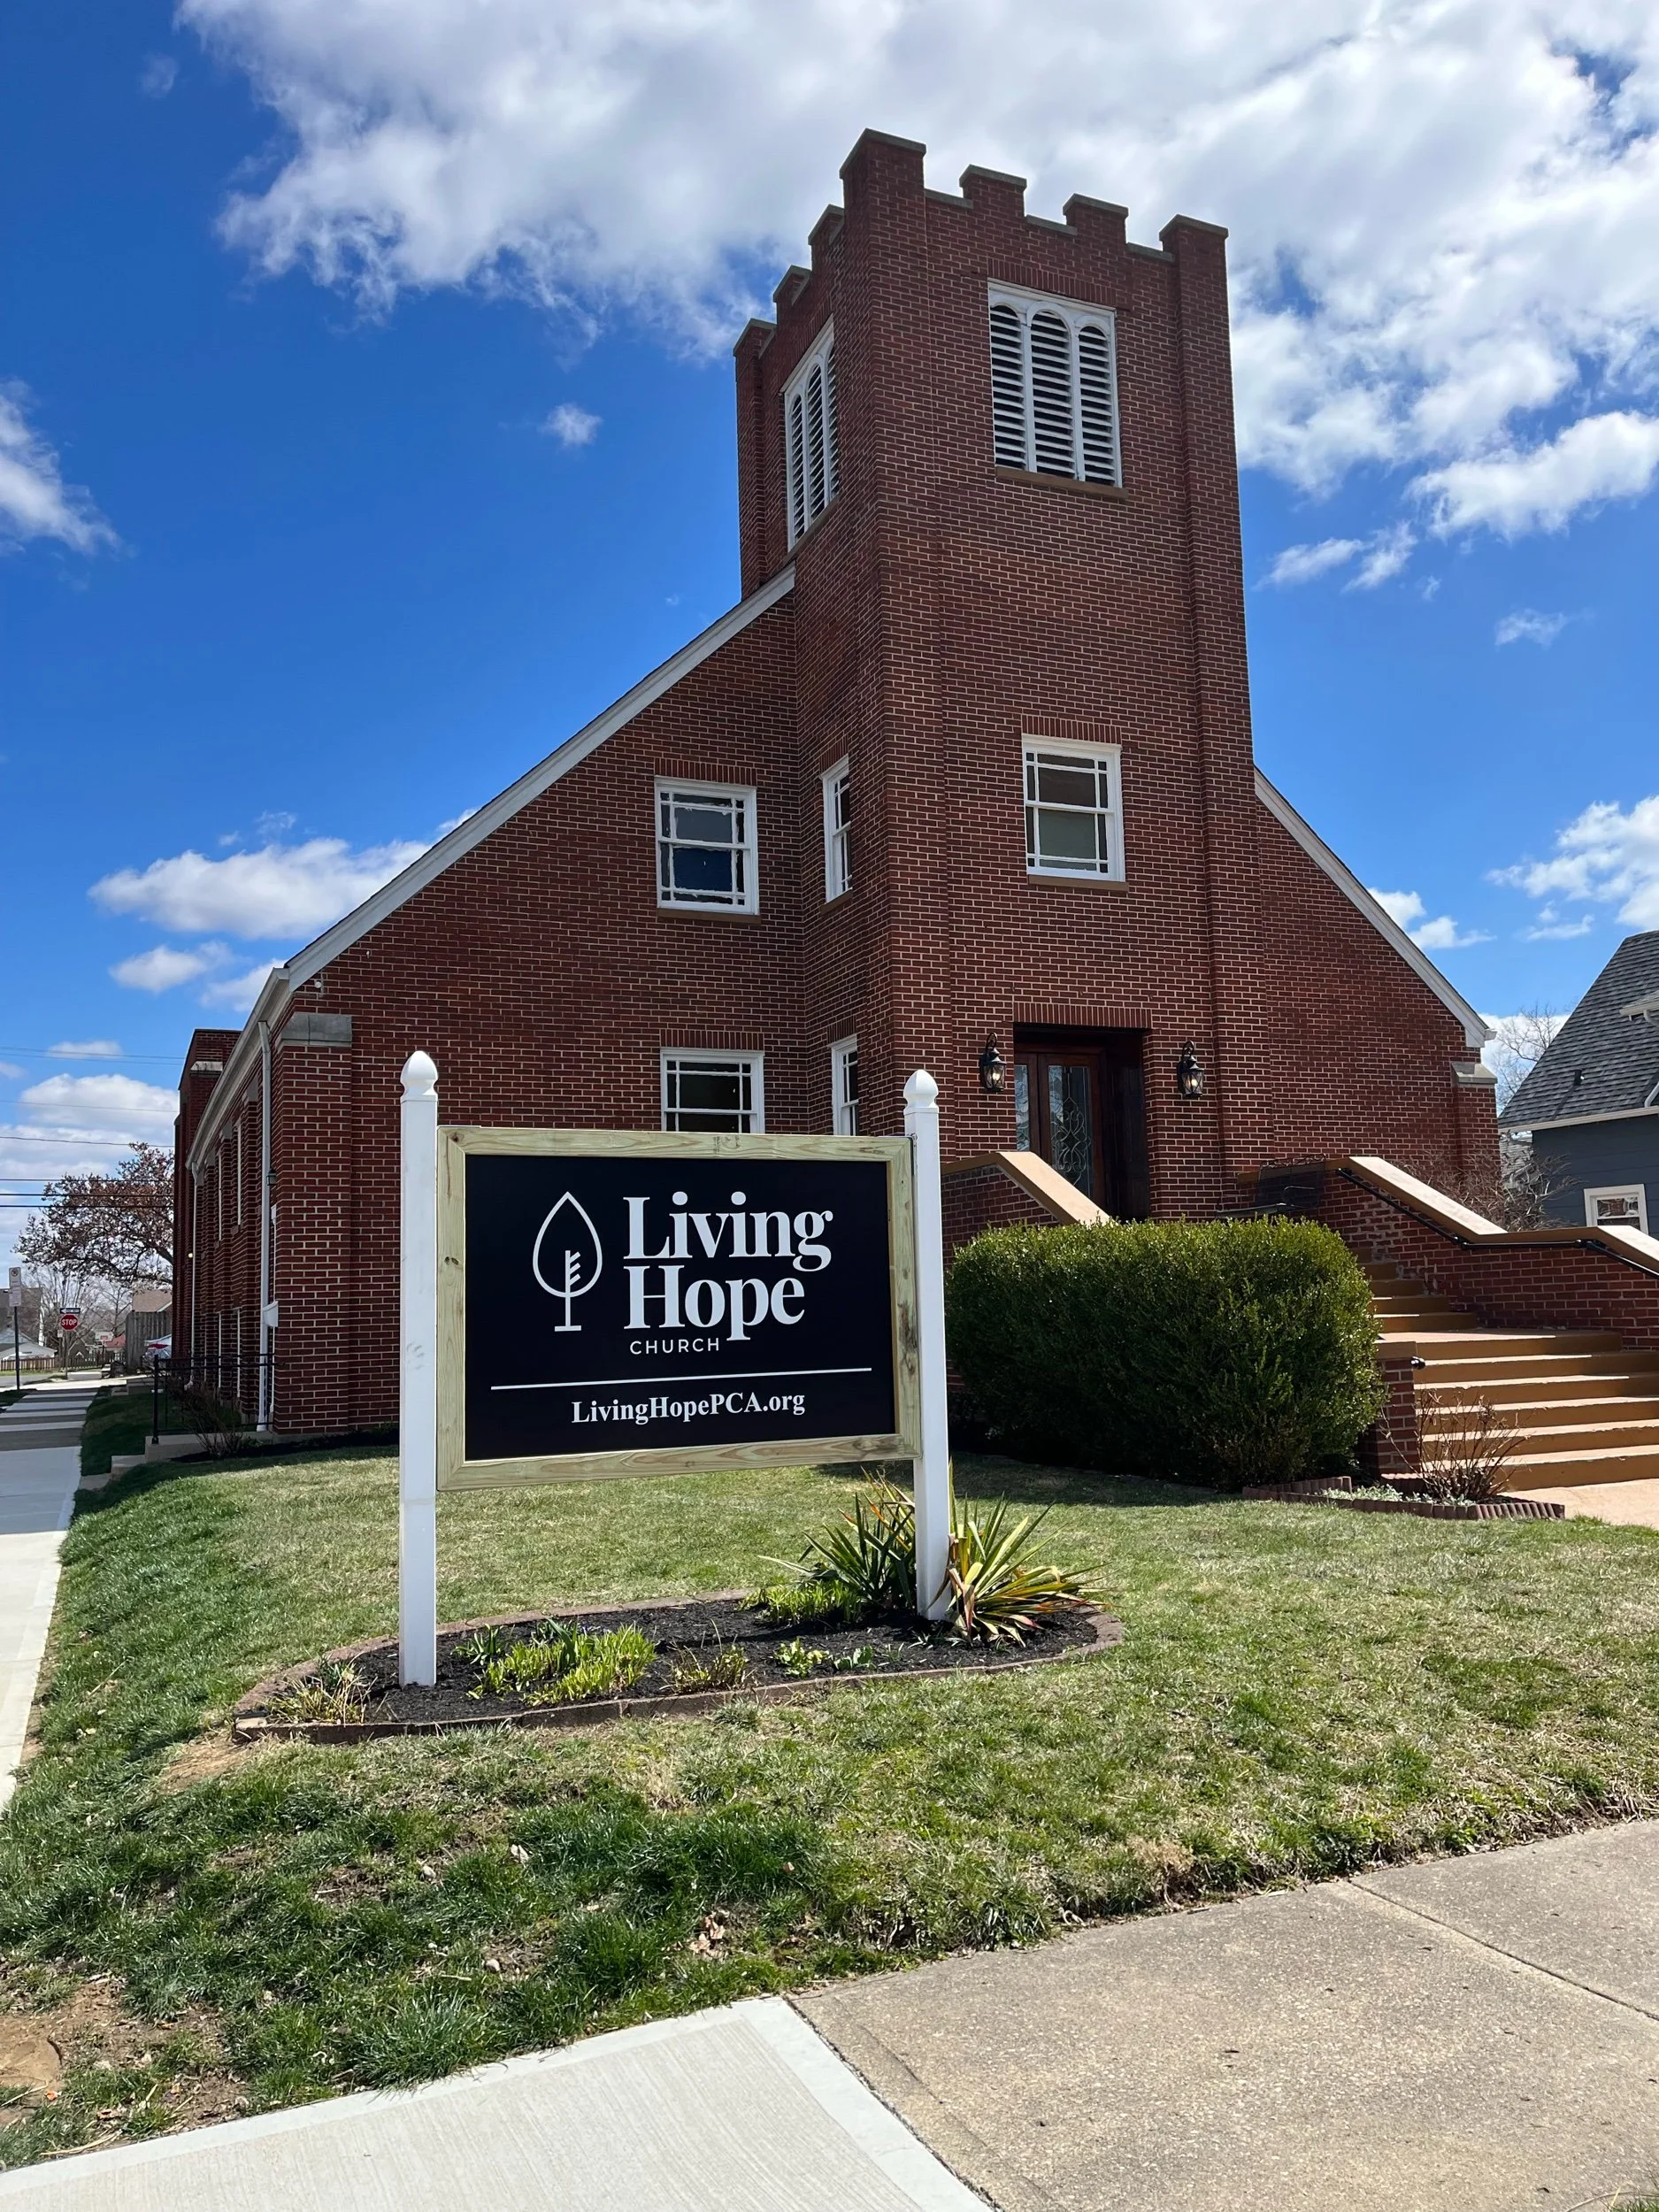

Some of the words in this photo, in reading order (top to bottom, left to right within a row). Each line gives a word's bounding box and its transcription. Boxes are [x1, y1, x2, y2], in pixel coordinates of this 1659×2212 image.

[623, 1191, 833, 1272] Living
[623, 1264, 805, 1341] Hope
[629, 1337, 720, 1356] CHURCH
[571, 1392, 806, 1425] LivingHopePCA.org
